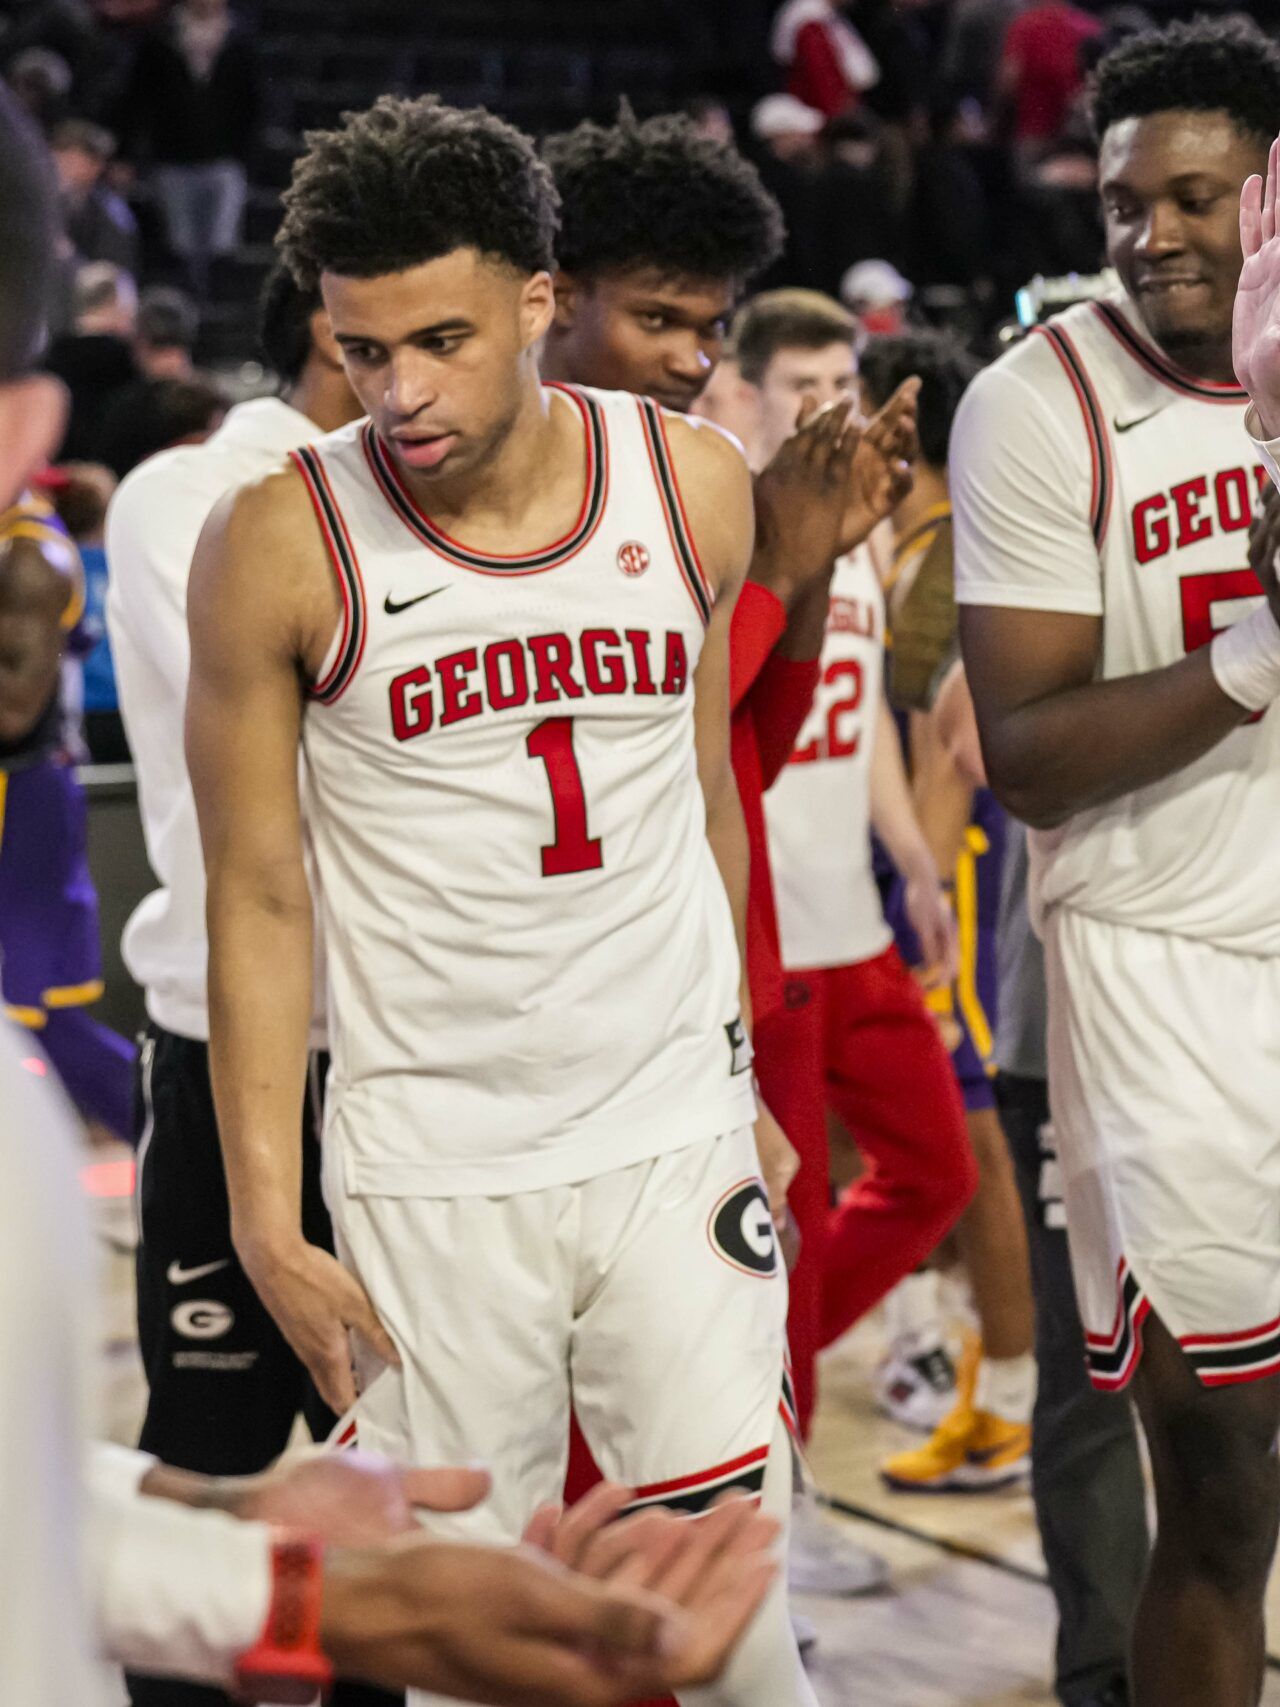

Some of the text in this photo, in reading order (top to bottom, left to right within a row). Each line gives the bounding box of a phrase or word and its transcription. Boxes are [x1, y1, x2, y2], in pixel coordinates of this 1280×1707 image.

[1131, 464, 1267, 565] GEO
[388, 628, 688, 742] GEORGIA
[526, 716, 604, 878] 1
[709, 1178, 777, 1276] G
[169, 1298, 236, 1340] G
